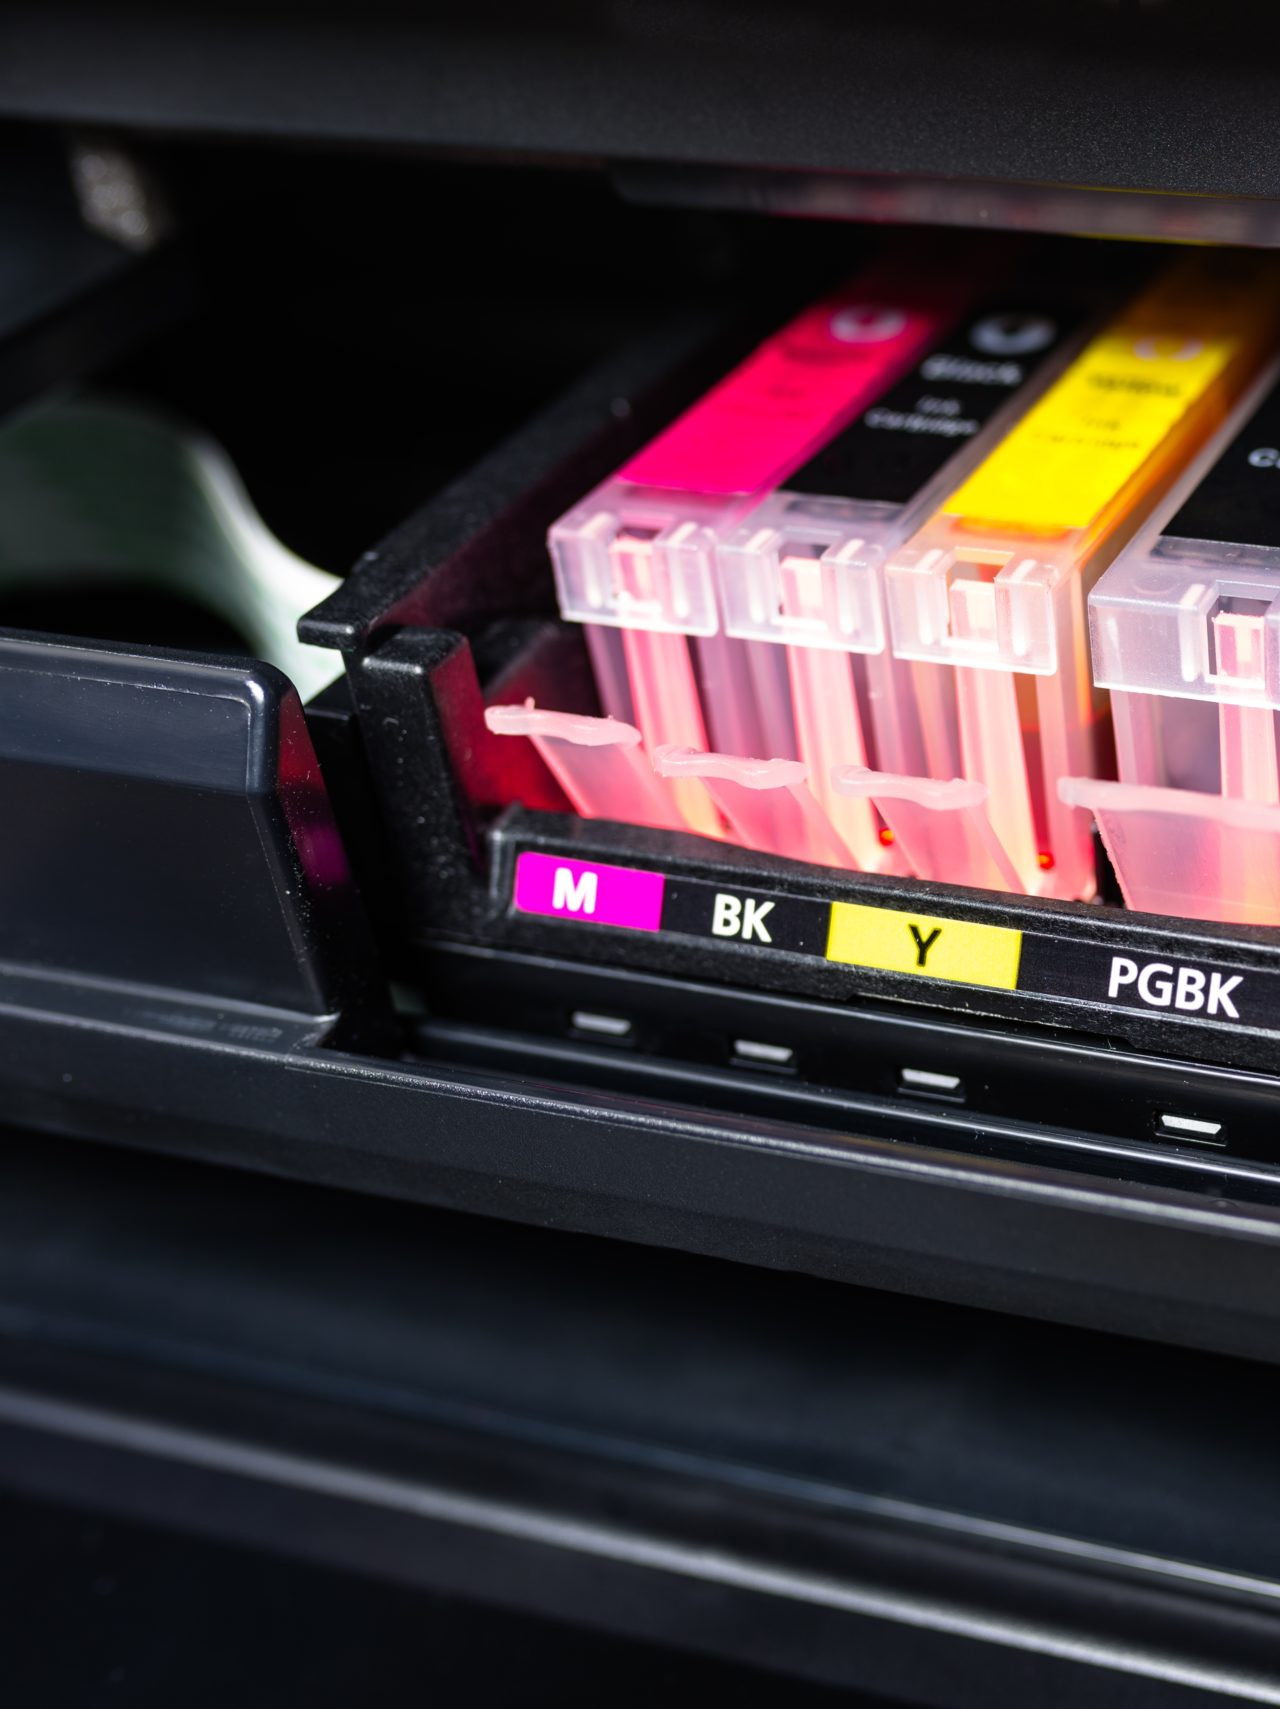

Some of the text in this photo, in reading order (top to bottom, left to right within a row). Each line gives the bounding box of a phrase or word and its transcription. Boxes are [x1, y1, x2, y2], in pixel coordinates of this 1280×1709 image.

[552, 867, 598, 915] M
[712, 893, 775, 943] BK
[908, 924, 942, 967] Y
[1107, 956, 1244, 1018] PGBK
